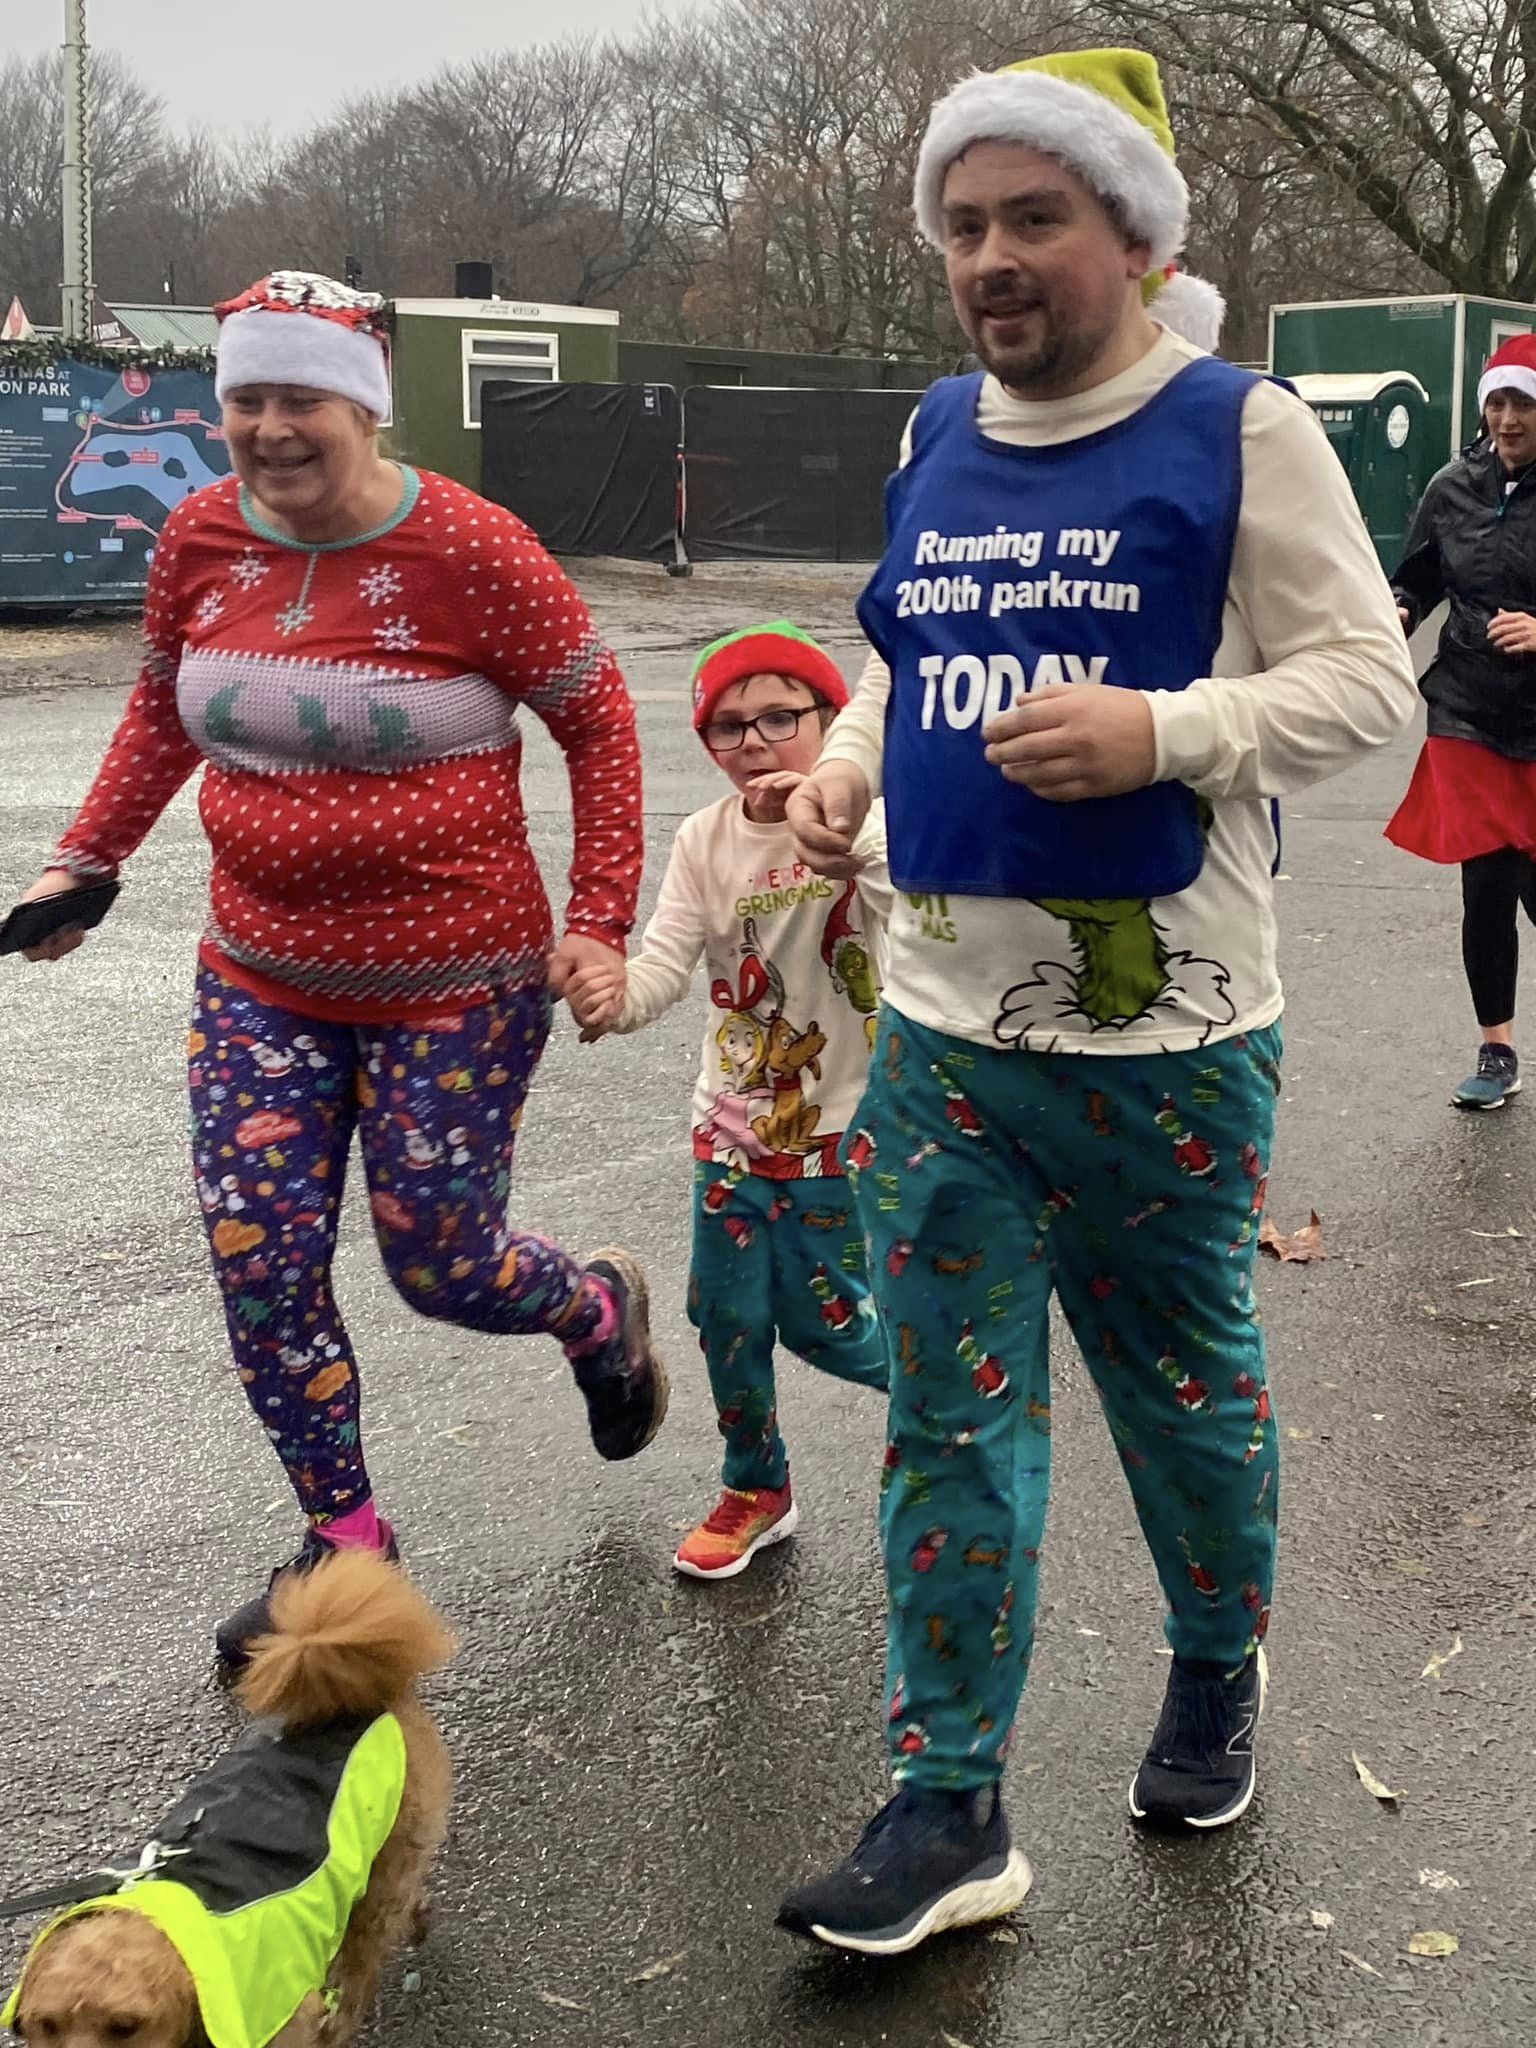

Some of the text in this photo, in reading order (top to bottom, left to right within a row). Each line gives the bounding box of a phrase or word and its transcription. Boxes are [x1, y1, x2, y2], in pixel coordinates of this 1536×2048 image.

[28, 382, 71, 397] PARK
[58, 371, 72, 380] AT
[914, 525, 1121, 567] Running my
[896, 571, 1141, 618] 200th parkrun
